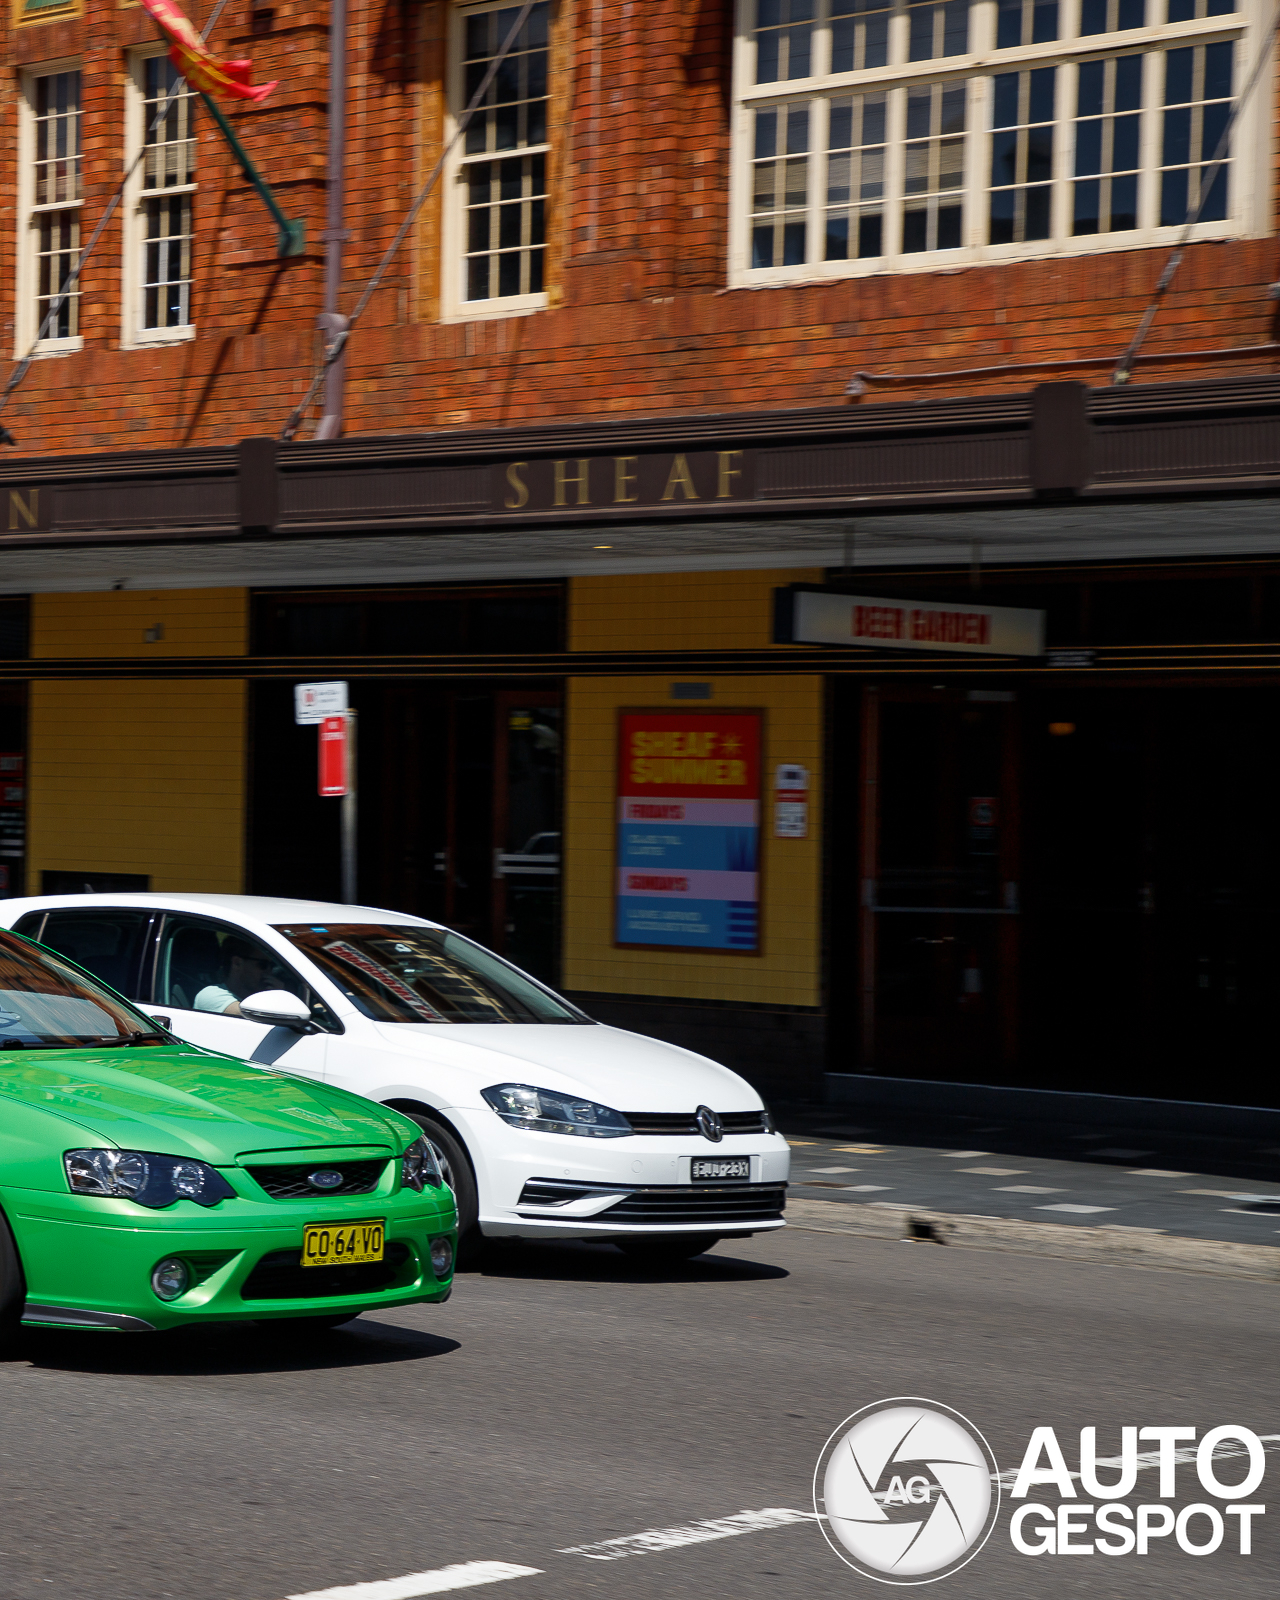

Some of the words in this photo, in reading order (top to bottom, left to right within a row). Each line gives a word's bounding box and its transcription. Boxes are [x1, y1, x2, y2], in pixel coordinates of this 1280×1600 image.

[504, 450, 744, 509] SHEAF
[853, 604, 904, 639] BEER
[910, 609, 993, 645] GARDEN
[629, 731, 719, 758] SHEAF
[628, 757, 749, 786] SUMMER
